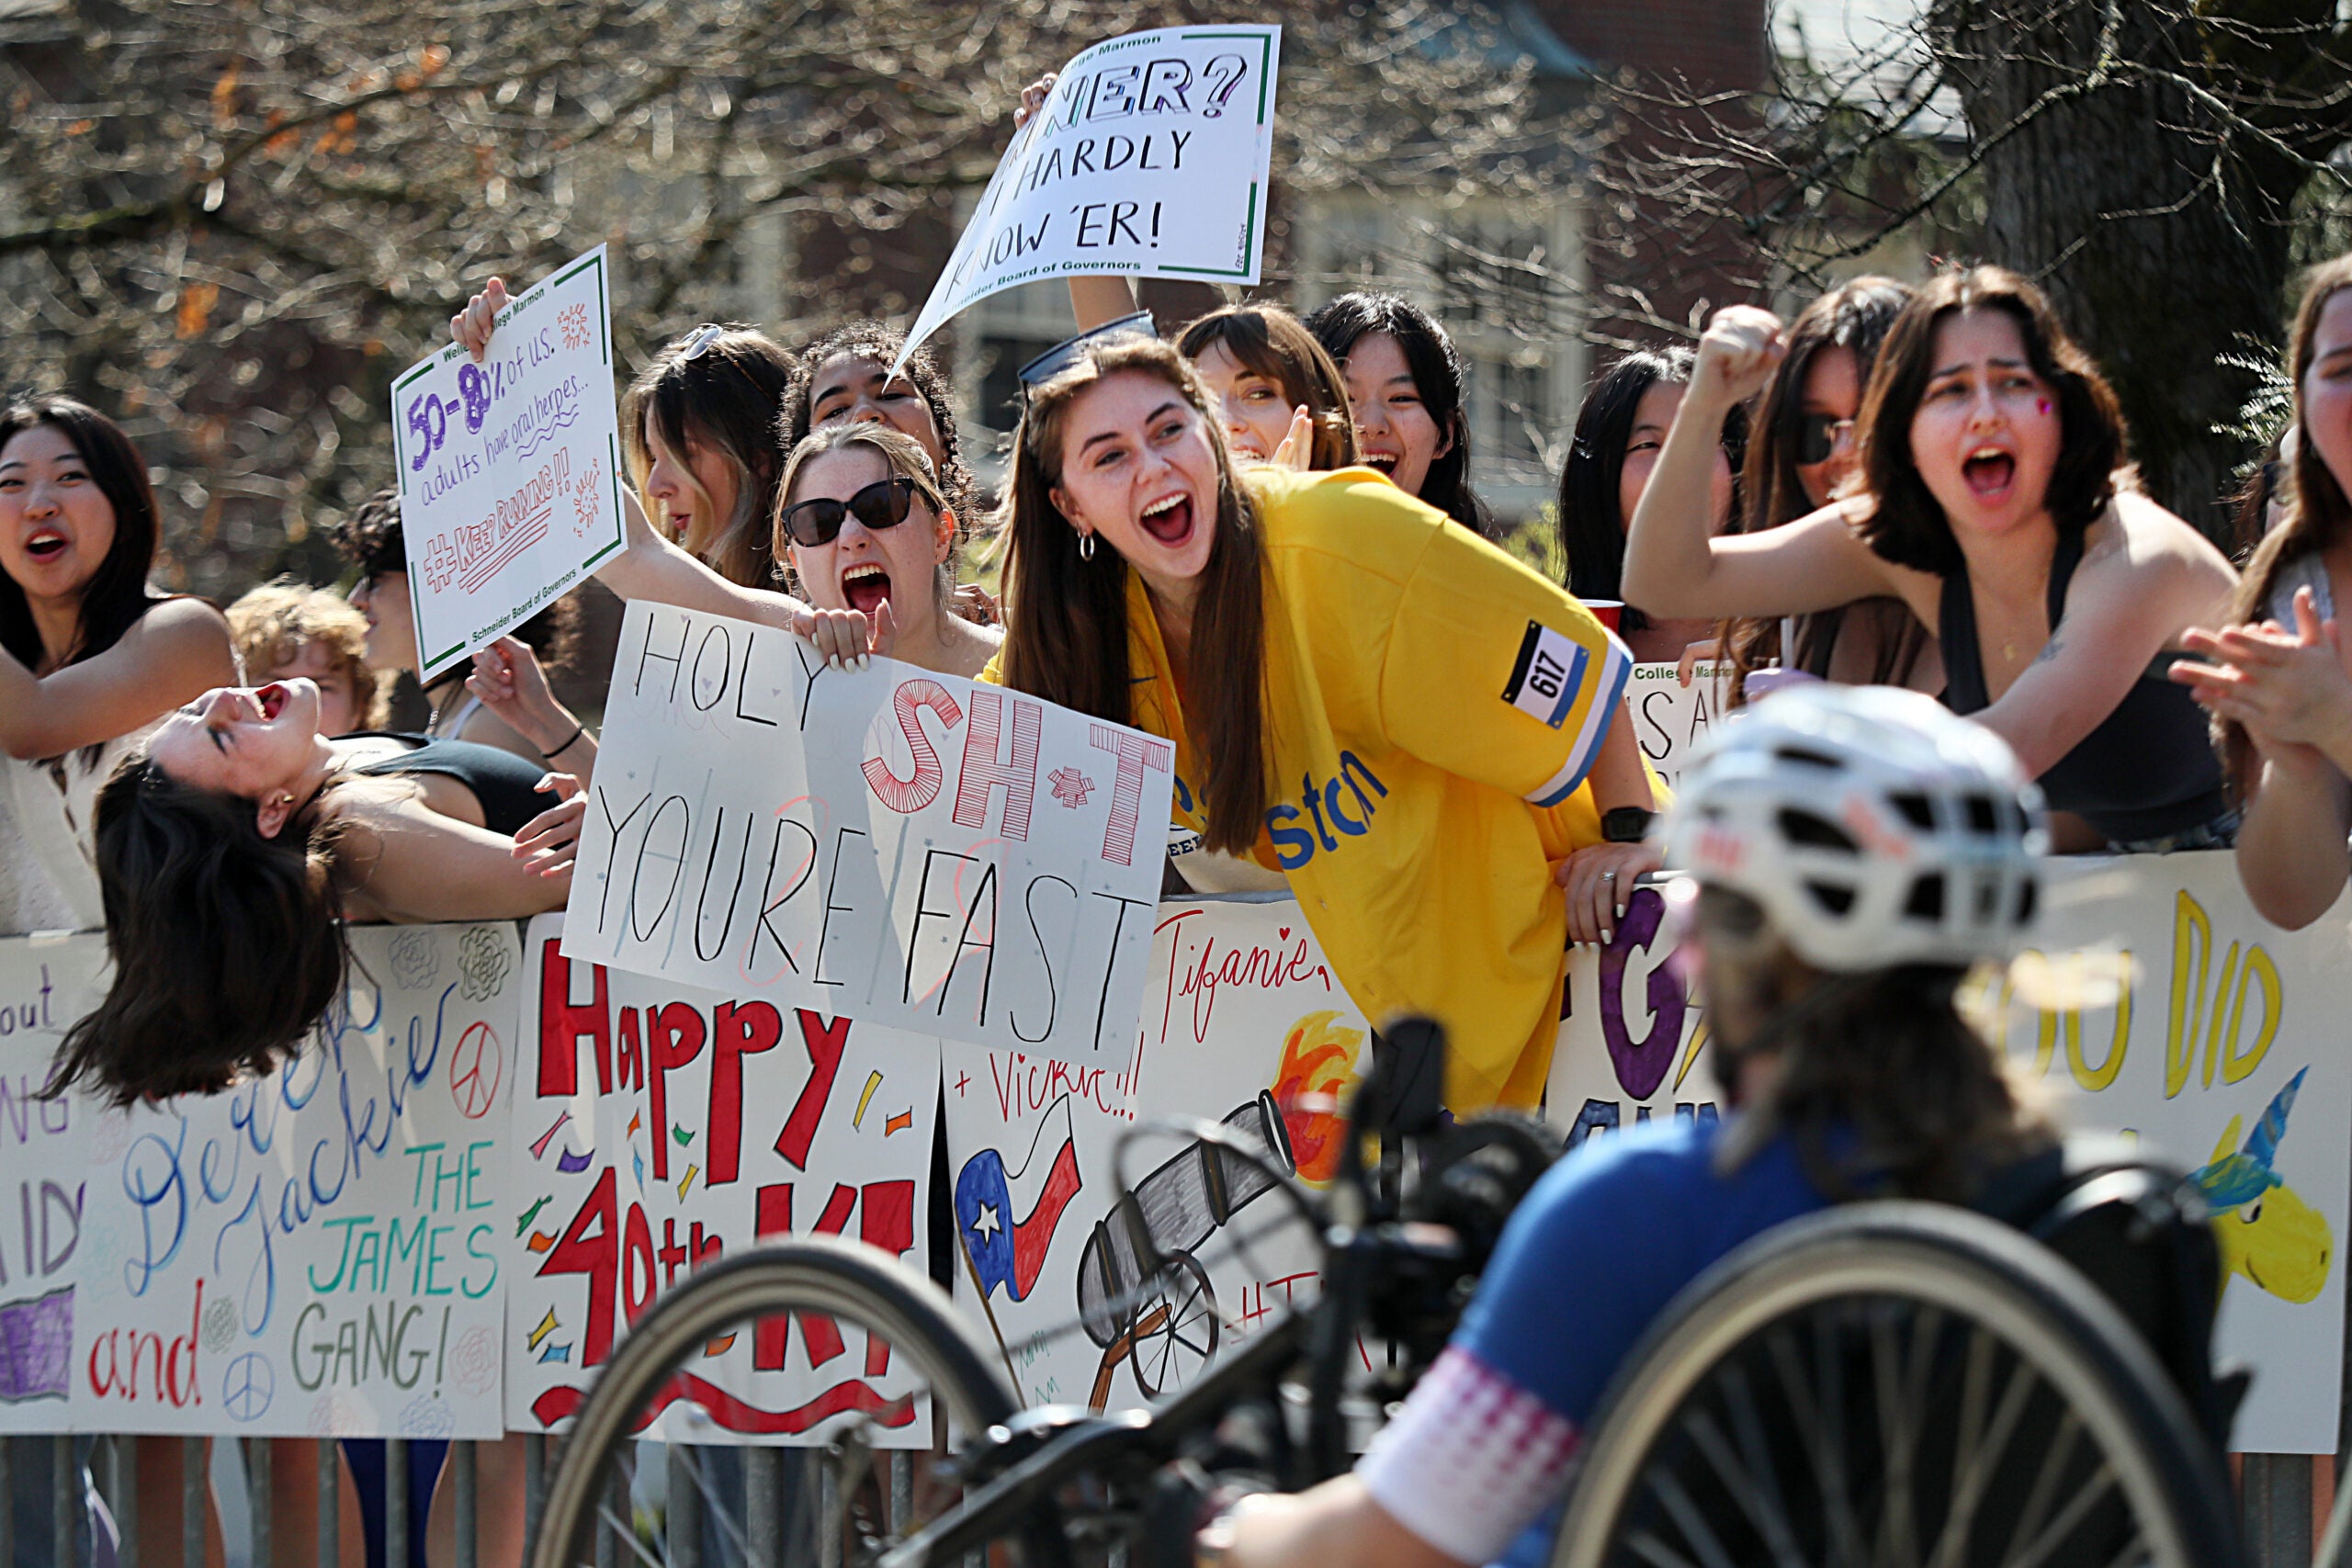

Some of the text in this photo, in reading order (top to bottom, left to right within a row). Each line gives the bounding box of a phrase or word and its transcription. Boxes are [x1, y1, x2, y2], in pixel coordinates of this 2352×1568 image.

[1099, 36, 1160, 55] Marmon
[1013, 130, 1192, 201] HARDLY
[944, 212, 1051, 303] KNOW
[998, 266, 1037, 286] Board
[1042, 263, 1057, 274] of
[1062, 260, 1142, 271] Governors
[513, 288, 545, 317] Marmon
[507, 346, 525, 385] of
[422, 453, 481, 506] adults
[484, 429, 510, 466] have
[511, 405, 536, 445] oral
[472, 569, 576, 643] Schneider Board of Governors
[634, 612, 828, 731] HOLY
[1530, 649, 1566, 699] 617
[598, 784, 1153, 1051] YOURE FAST
[2165, 888, 2283, 1100] DID
[404, 1141, 493, 1213] THE
[308, 1214, 499, 1300] JAMES
[88, 1278, 203, 1408] and
[292, 1300, 450, 1399] GANG!
